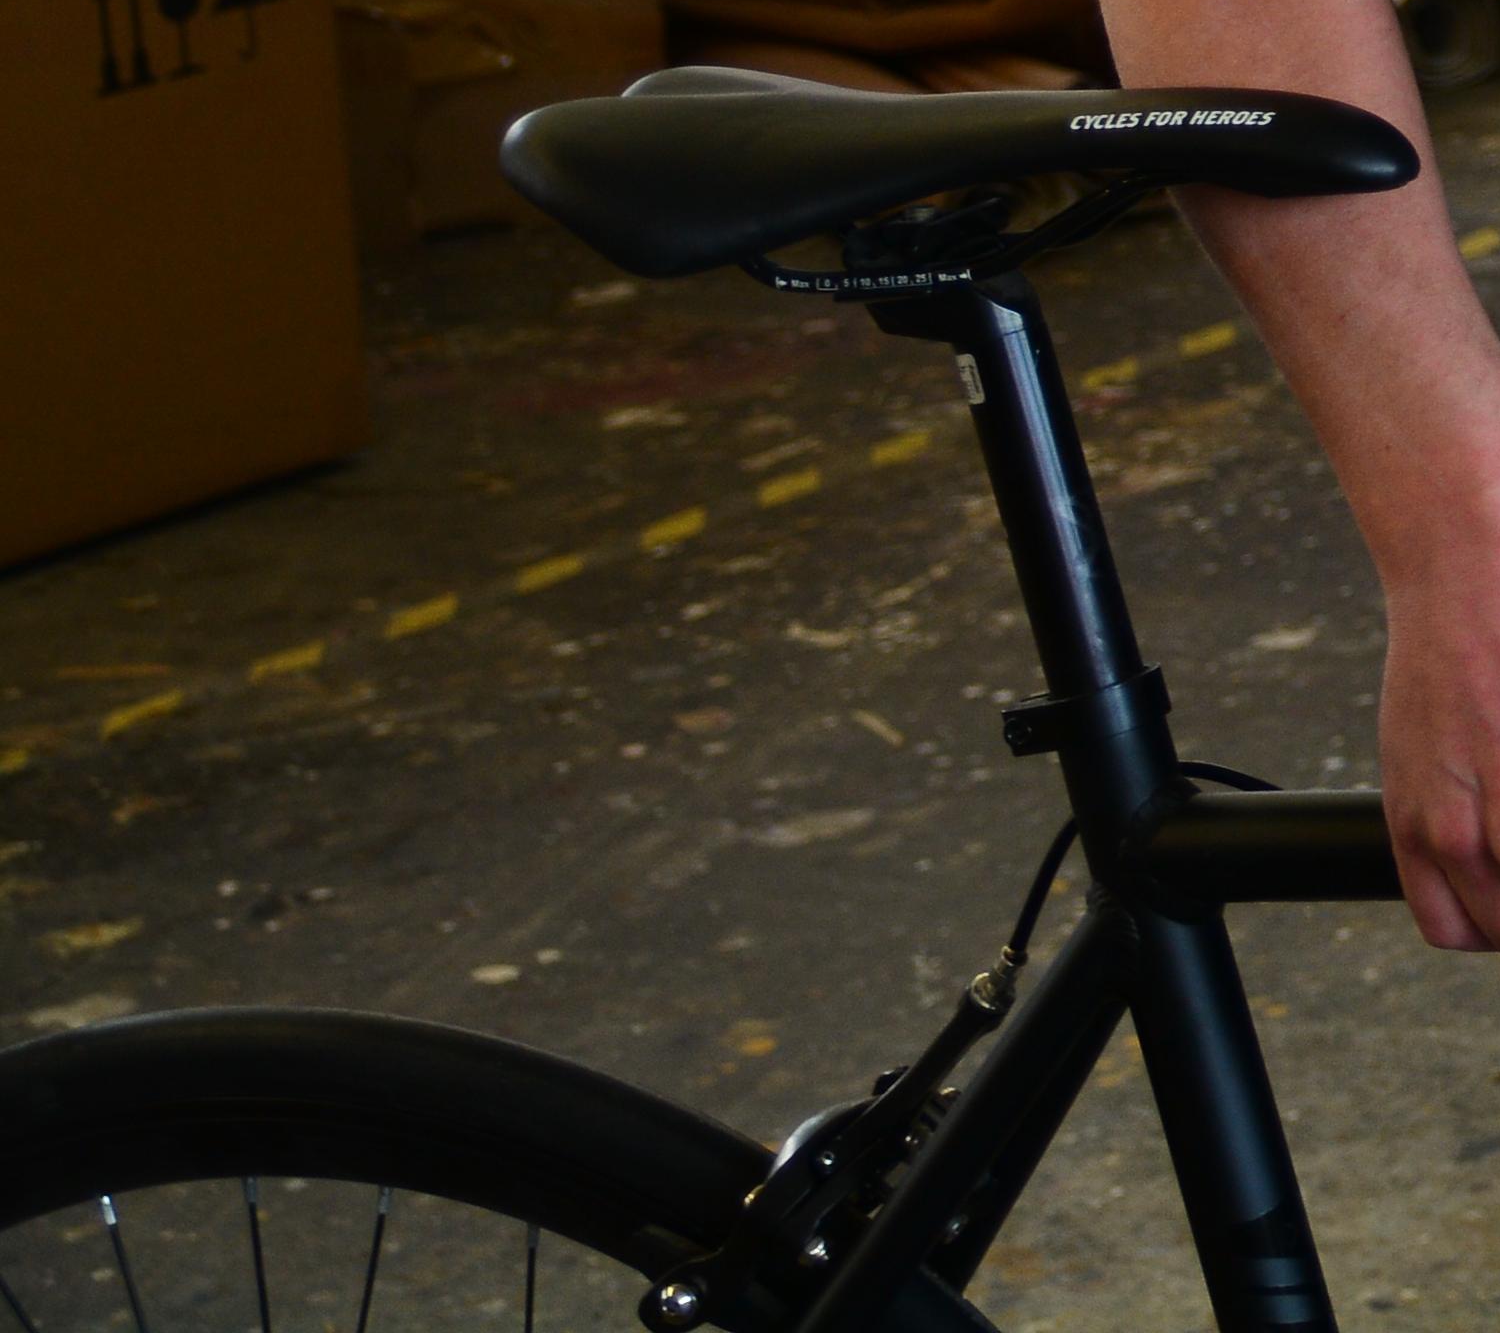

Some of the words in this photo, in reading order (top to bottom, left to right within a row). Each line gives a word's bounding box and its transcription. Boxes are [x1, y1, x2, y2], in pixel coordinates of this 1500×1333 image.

[1070, 113, 1142, 130] CYCLES
[1144, 111, 1188, 127] FOR
[1190, 110, 1276, 126] HEROES
